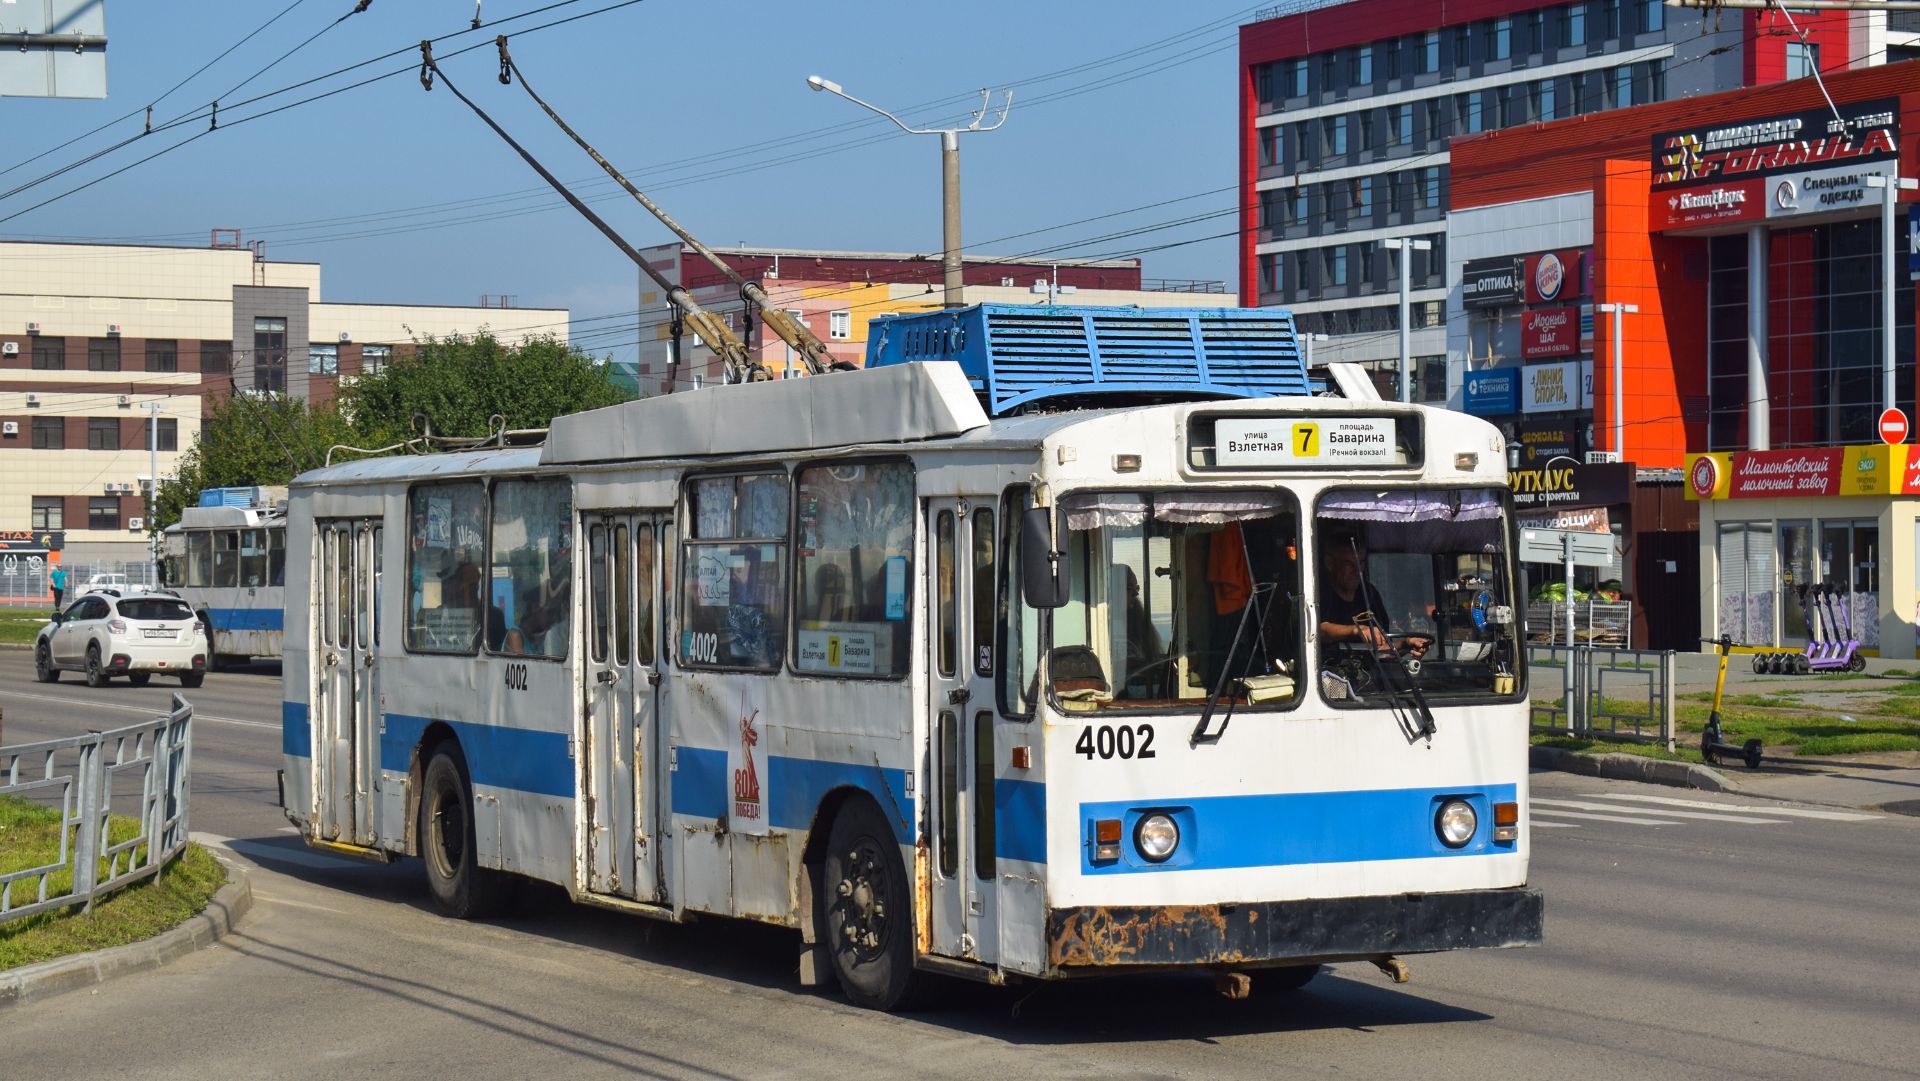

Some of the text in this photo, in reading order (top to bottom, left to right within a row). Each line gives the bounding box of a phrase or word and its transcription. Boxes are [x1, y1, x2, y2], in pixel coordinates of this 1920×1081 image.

[1705, 118, 1802, 150] КИНОТЕАТР
[1697, 129, 1897, 177] FORMULA
[1820, 189, 1864, 205] одежда
[1539, 262, 1559, 279] BURGER
[1478, 275, 1513, 292] ОПТИКА
[1540, 270, 1560, 289] KING
[1528, 311, 1567, 332] Модный
[1540, 332, 1556, 343] ШАГ
[1552, 344, 1570, 352] ОБУВЬ
[1535, 368, 1563, 386] ЛИНИЯ
[1535, 384, 1564, 404] СПОРТА
[1244, 432, 1268, 440] улица
[1339, 424, 1374, 432] площадь
[1229, 441, 1283, 452] Взлетная
[1299, 428, 1313, 452] 7
[1329, 432, 1385, 446] Баварина
[1329, 448, 1386, 457] (Речной вокзал)
[1740, 456, 1829, 475] Мамонтовский
[1858, 459, 1874, 471] ЭКО
[1740, 473, 1828, 494] молочный завод
[1546, 514, 1595, 529] ОВОЩИ
[690, 631, 717, 664] 4002
[831, 640, 838, 662] 7
[505, 663, 527, 691] 4002
[1075, 723, 1156, 761] 4002
[735, 803, 761, 820] ПОБЕДА!
